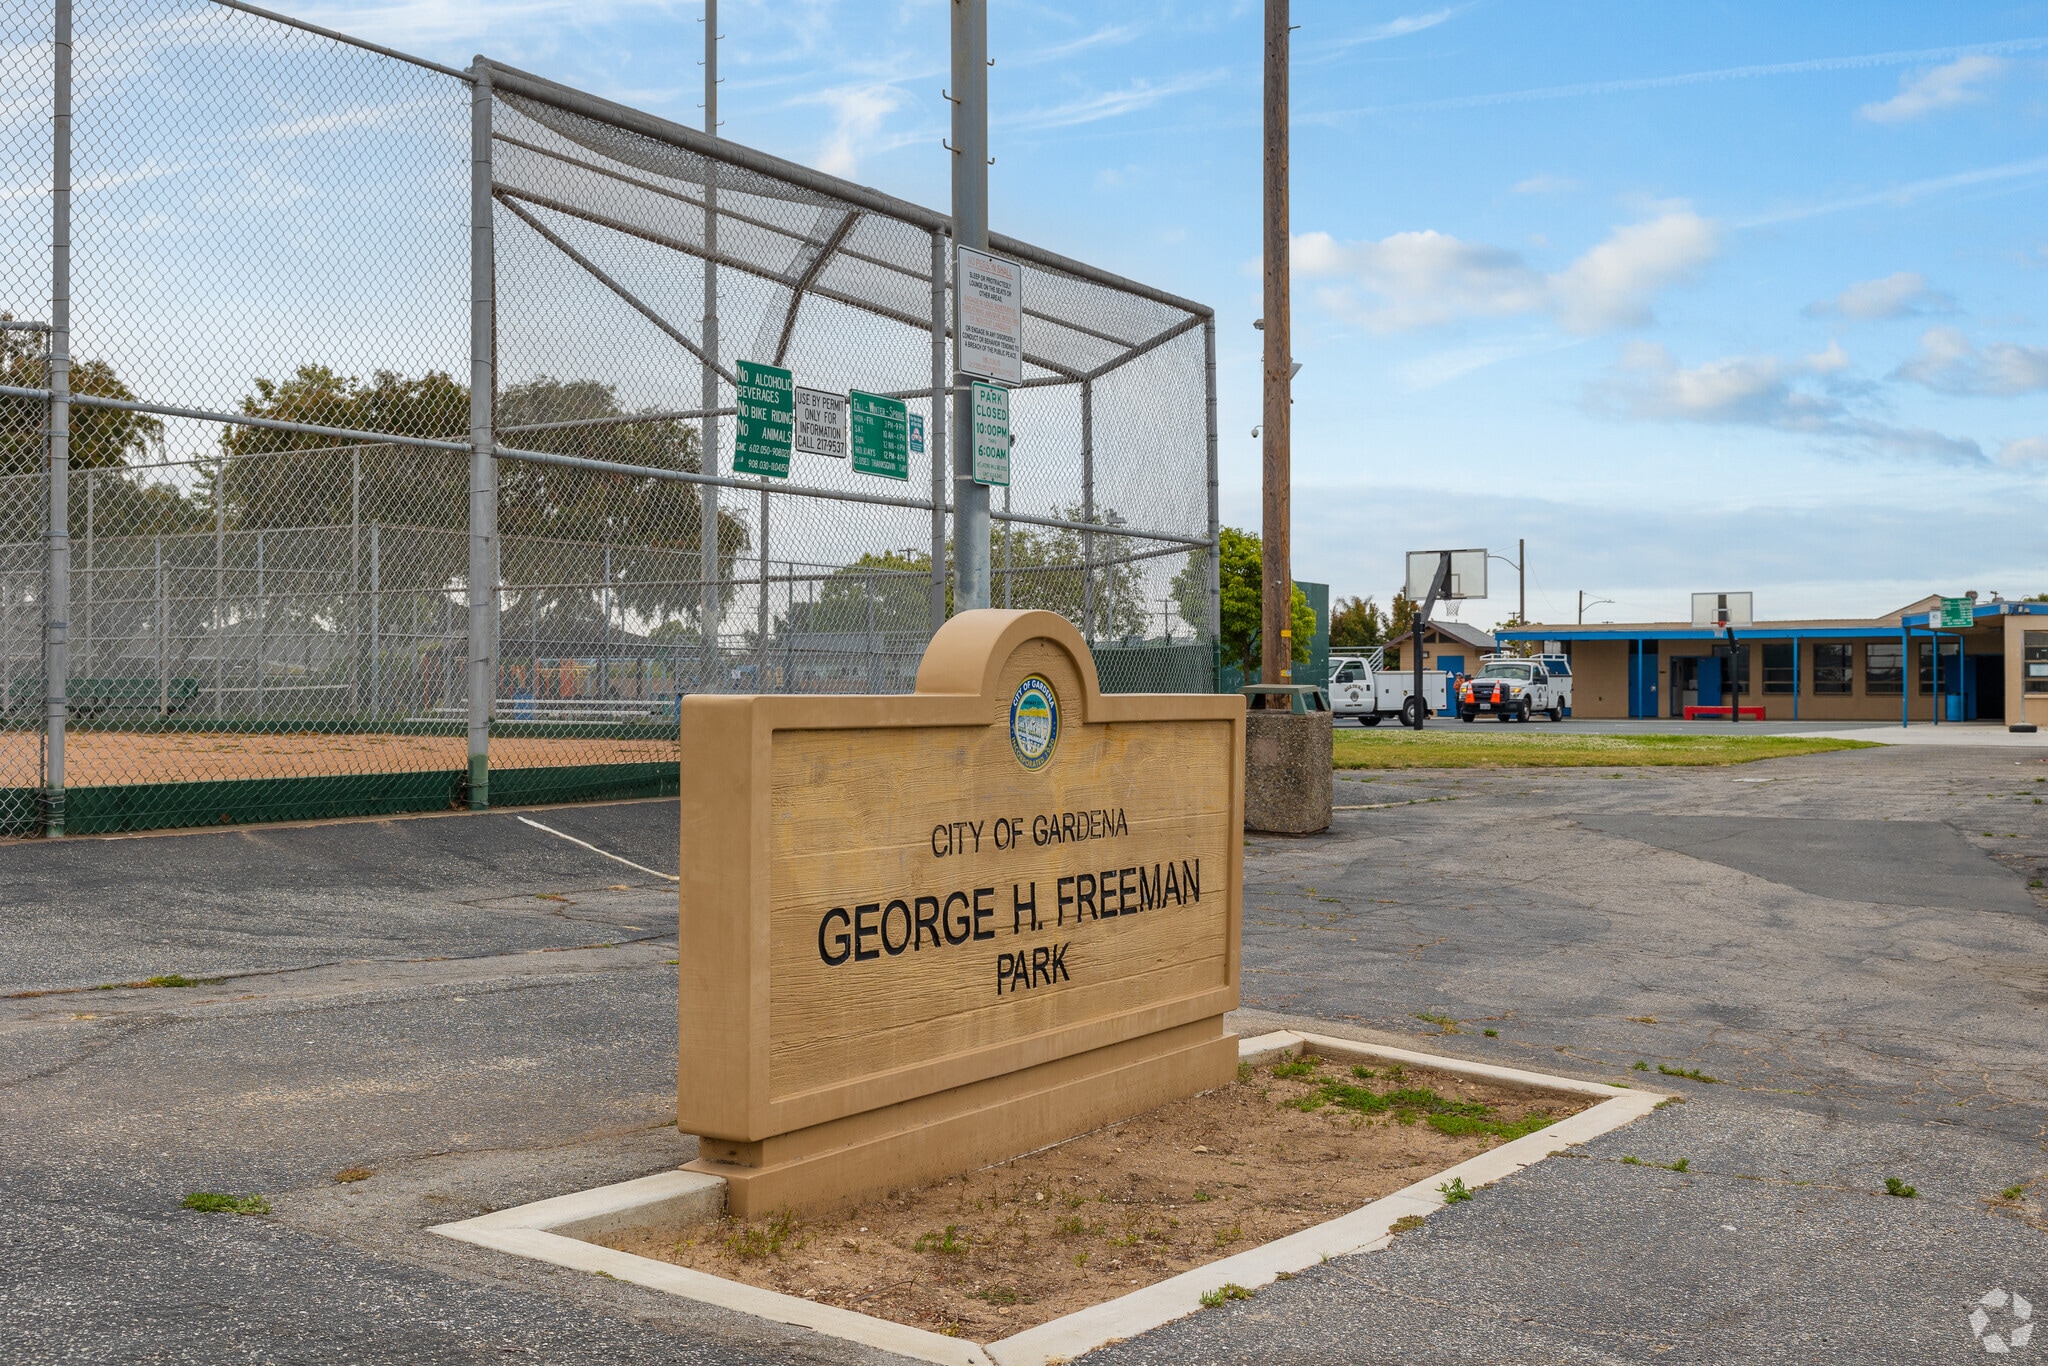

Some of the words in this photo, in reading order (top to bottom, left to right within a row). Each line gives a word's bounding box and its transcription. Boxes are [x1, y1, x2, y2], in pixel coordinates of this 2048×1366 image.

[969, 271, 980, 280] SLEEP
[969, 279, 983, 289] LOUNGE
[996, 287, 1006, 296] SEATS
[979, 290, 990, 298] OTHER
[962, 331, 978, 341] CONDUCT
[985, 337, 1000, 346] BEHAVIOR
[1001, 341, 1014, 351] TENDING
[971, 326, 985, 335] ENGAGE
[997, 333, 1016, 343] DISORDERLY
[968, 341, 981, 350] BREACH
[994, 348, 1005, 356] PUBLIC
[755, 373, 792, 391] ALCOHOLIC
[738, 385, 779, 404] BEVERAGES
[798, 392, 810, 405] USE
[812, 395, 820, 407] BY
[822, 397, 844, 412] PERMIT
[981, 390, 1002, 405] PARK
[751, 406, 767, 420] BIKE
[771, 410, 793, 424] RIDING
[805, 408, 821, 422] ONLY
[824, 411, 837, 424] FOR
[976, 404, 1006, 421] CLOSED
[762, 427, 792, 443] ANIMALS
[800, 421, 841, 439] INFORMATION
[976, 422, 1007, 438] 10:00PM
[798, 435, 814, 448] CALL
[817, 438, 844, 453] 217-9537
[978, 445, 1006, 459] 6:00AM
[1013, 688, 1023, 707] CITY
[1023, 680, 1030, 691] OF
[1031, 680, 1055, 709] GARDENA
[931, 819, 985, 858] CITY
[994, 816, 1025, 850] OF
[1032, 808, 1129, 846] GARDENA
[818, 887, 996, 967] GEORGE
[1013, 881, 1043, 934] H.
[1057, 858, 1200, 927] FREEMAN
[996, 941, 1071, 996] PARK
